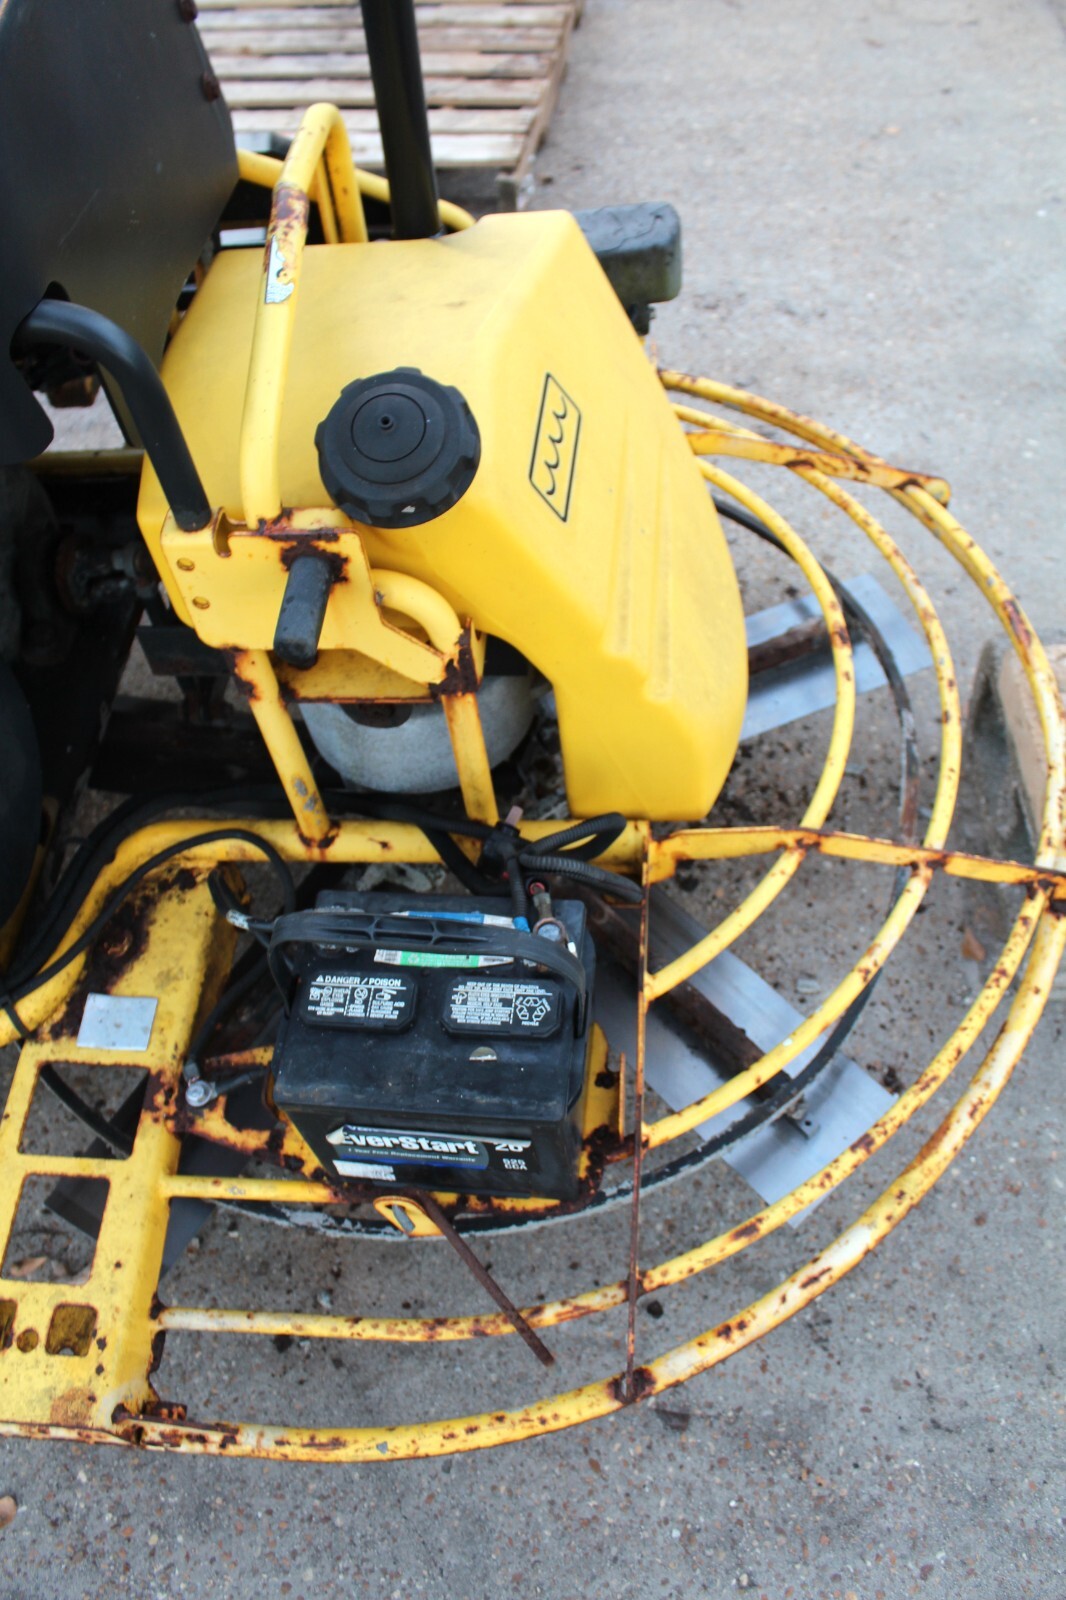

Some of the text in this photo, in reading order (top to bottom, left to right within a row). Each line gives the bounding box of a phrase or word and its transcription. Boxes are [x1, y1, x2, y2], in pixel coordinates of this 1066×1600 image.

[325, 975, 360, 985] DANGER
[368, 977, 402, 987] POISON
[342, 1132, 479, 1155] EverStart
